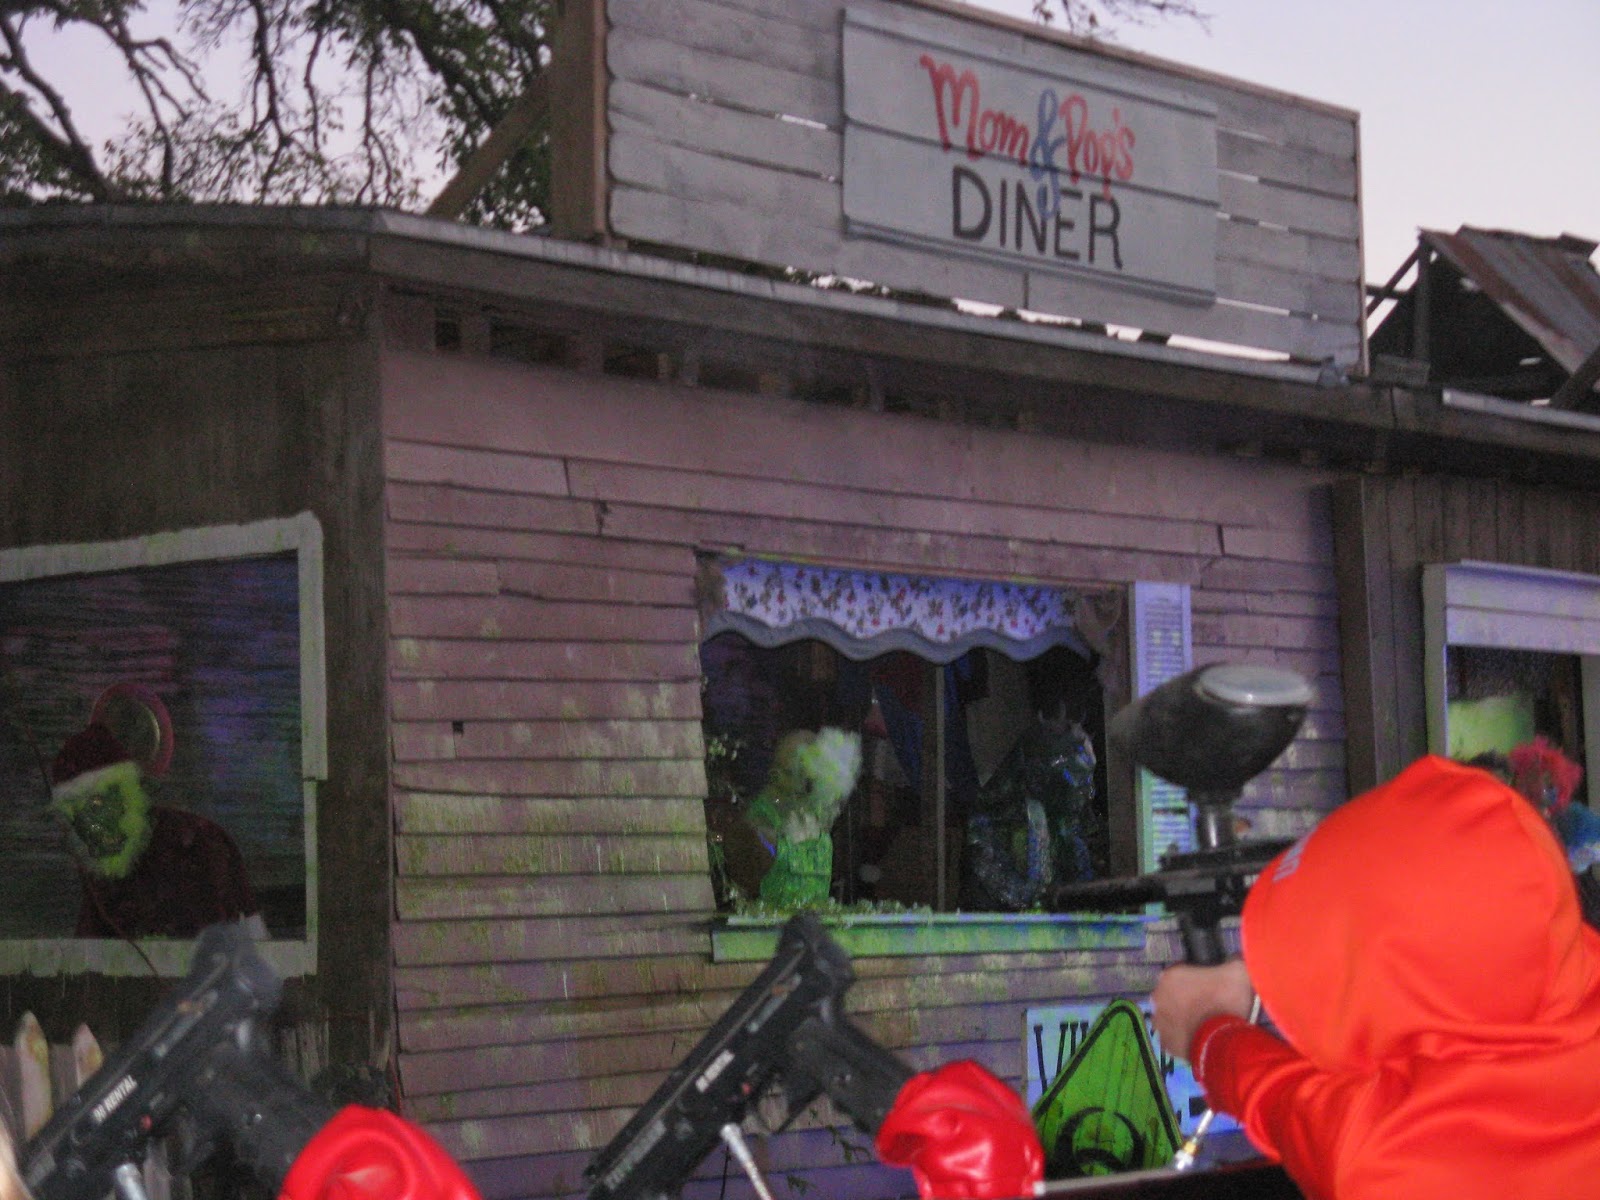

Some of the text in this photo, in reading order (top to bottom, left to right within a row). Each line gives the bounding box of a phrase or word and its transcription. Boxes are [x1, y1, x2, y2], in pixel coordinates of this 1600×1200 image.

[919, 54, 1136, 220] Mom & Pop's
[952, 164, 1123, 270] DINER
